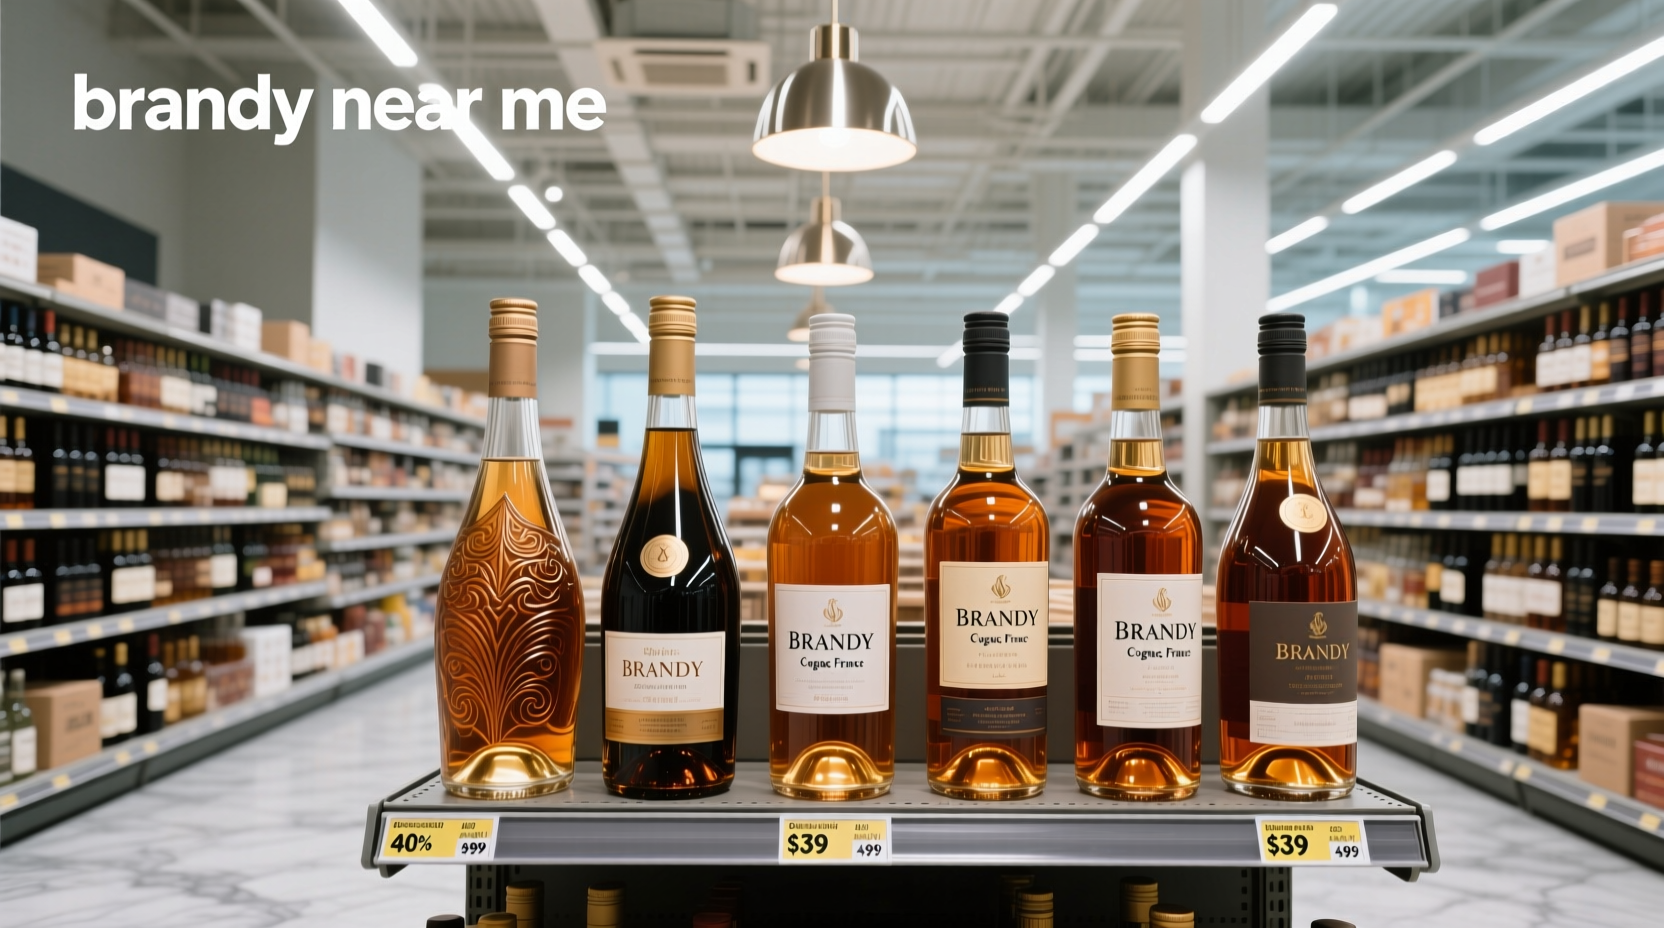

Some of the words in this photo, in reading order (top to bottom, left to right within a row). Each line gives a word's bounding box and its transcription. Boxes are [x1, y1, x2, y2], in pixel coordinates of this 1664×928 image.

[956, 608, 1039, 627] BRANDY
[788, 630, 874, 651] BRANDY
[1115, 620, 1197, 641] BRANDY
[1275, 642, 1350, 661] BRANDY
[622, 659, 703, 678] BRANDY
[390, 833, 432, 853] 40%
[787, 833, 829, 856] $39
[856, 843, 882, 857] 499
[1267, 833, 1308, 857] $39
